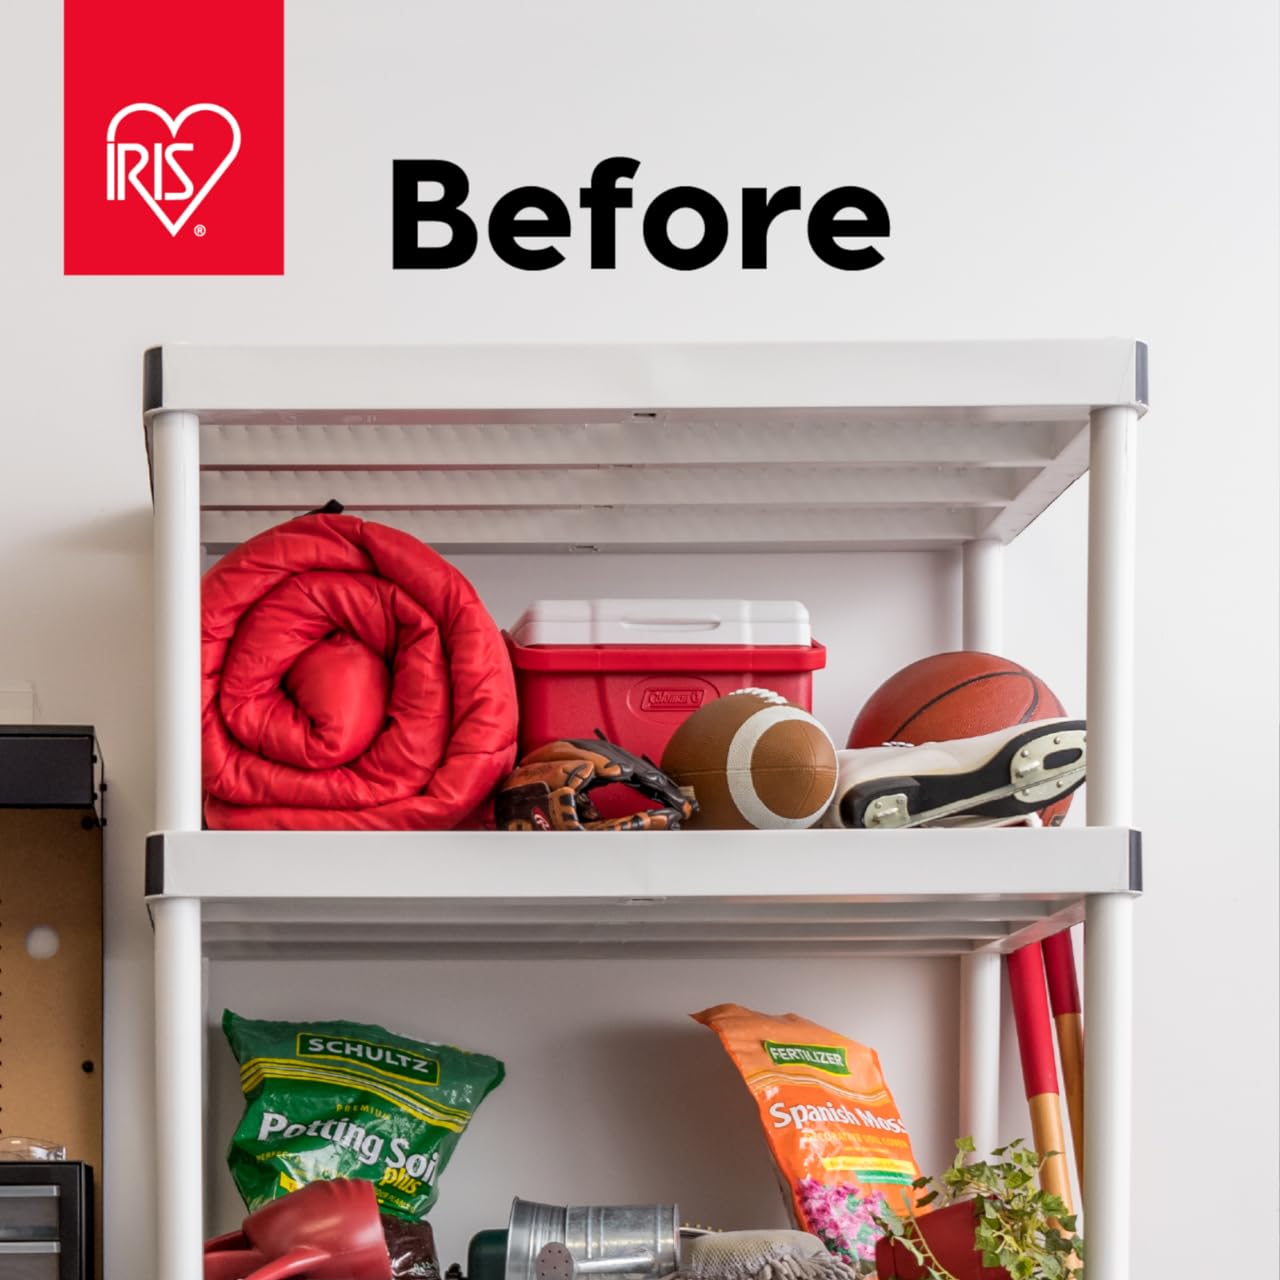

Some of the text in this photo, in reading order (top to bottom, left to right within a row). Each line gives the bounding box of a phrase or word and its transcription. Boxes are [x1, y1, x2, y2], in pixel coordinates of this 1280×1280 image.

[308, 1038, 429, 1073] SCHULTZ
[770, 1047, 845, 1067] FERTILIZER
[769, 1102, 861, 1129] Spanish
[257, 1112, 440, 1186] Potting Soi
[379, 1166, 422, 1195] plus
